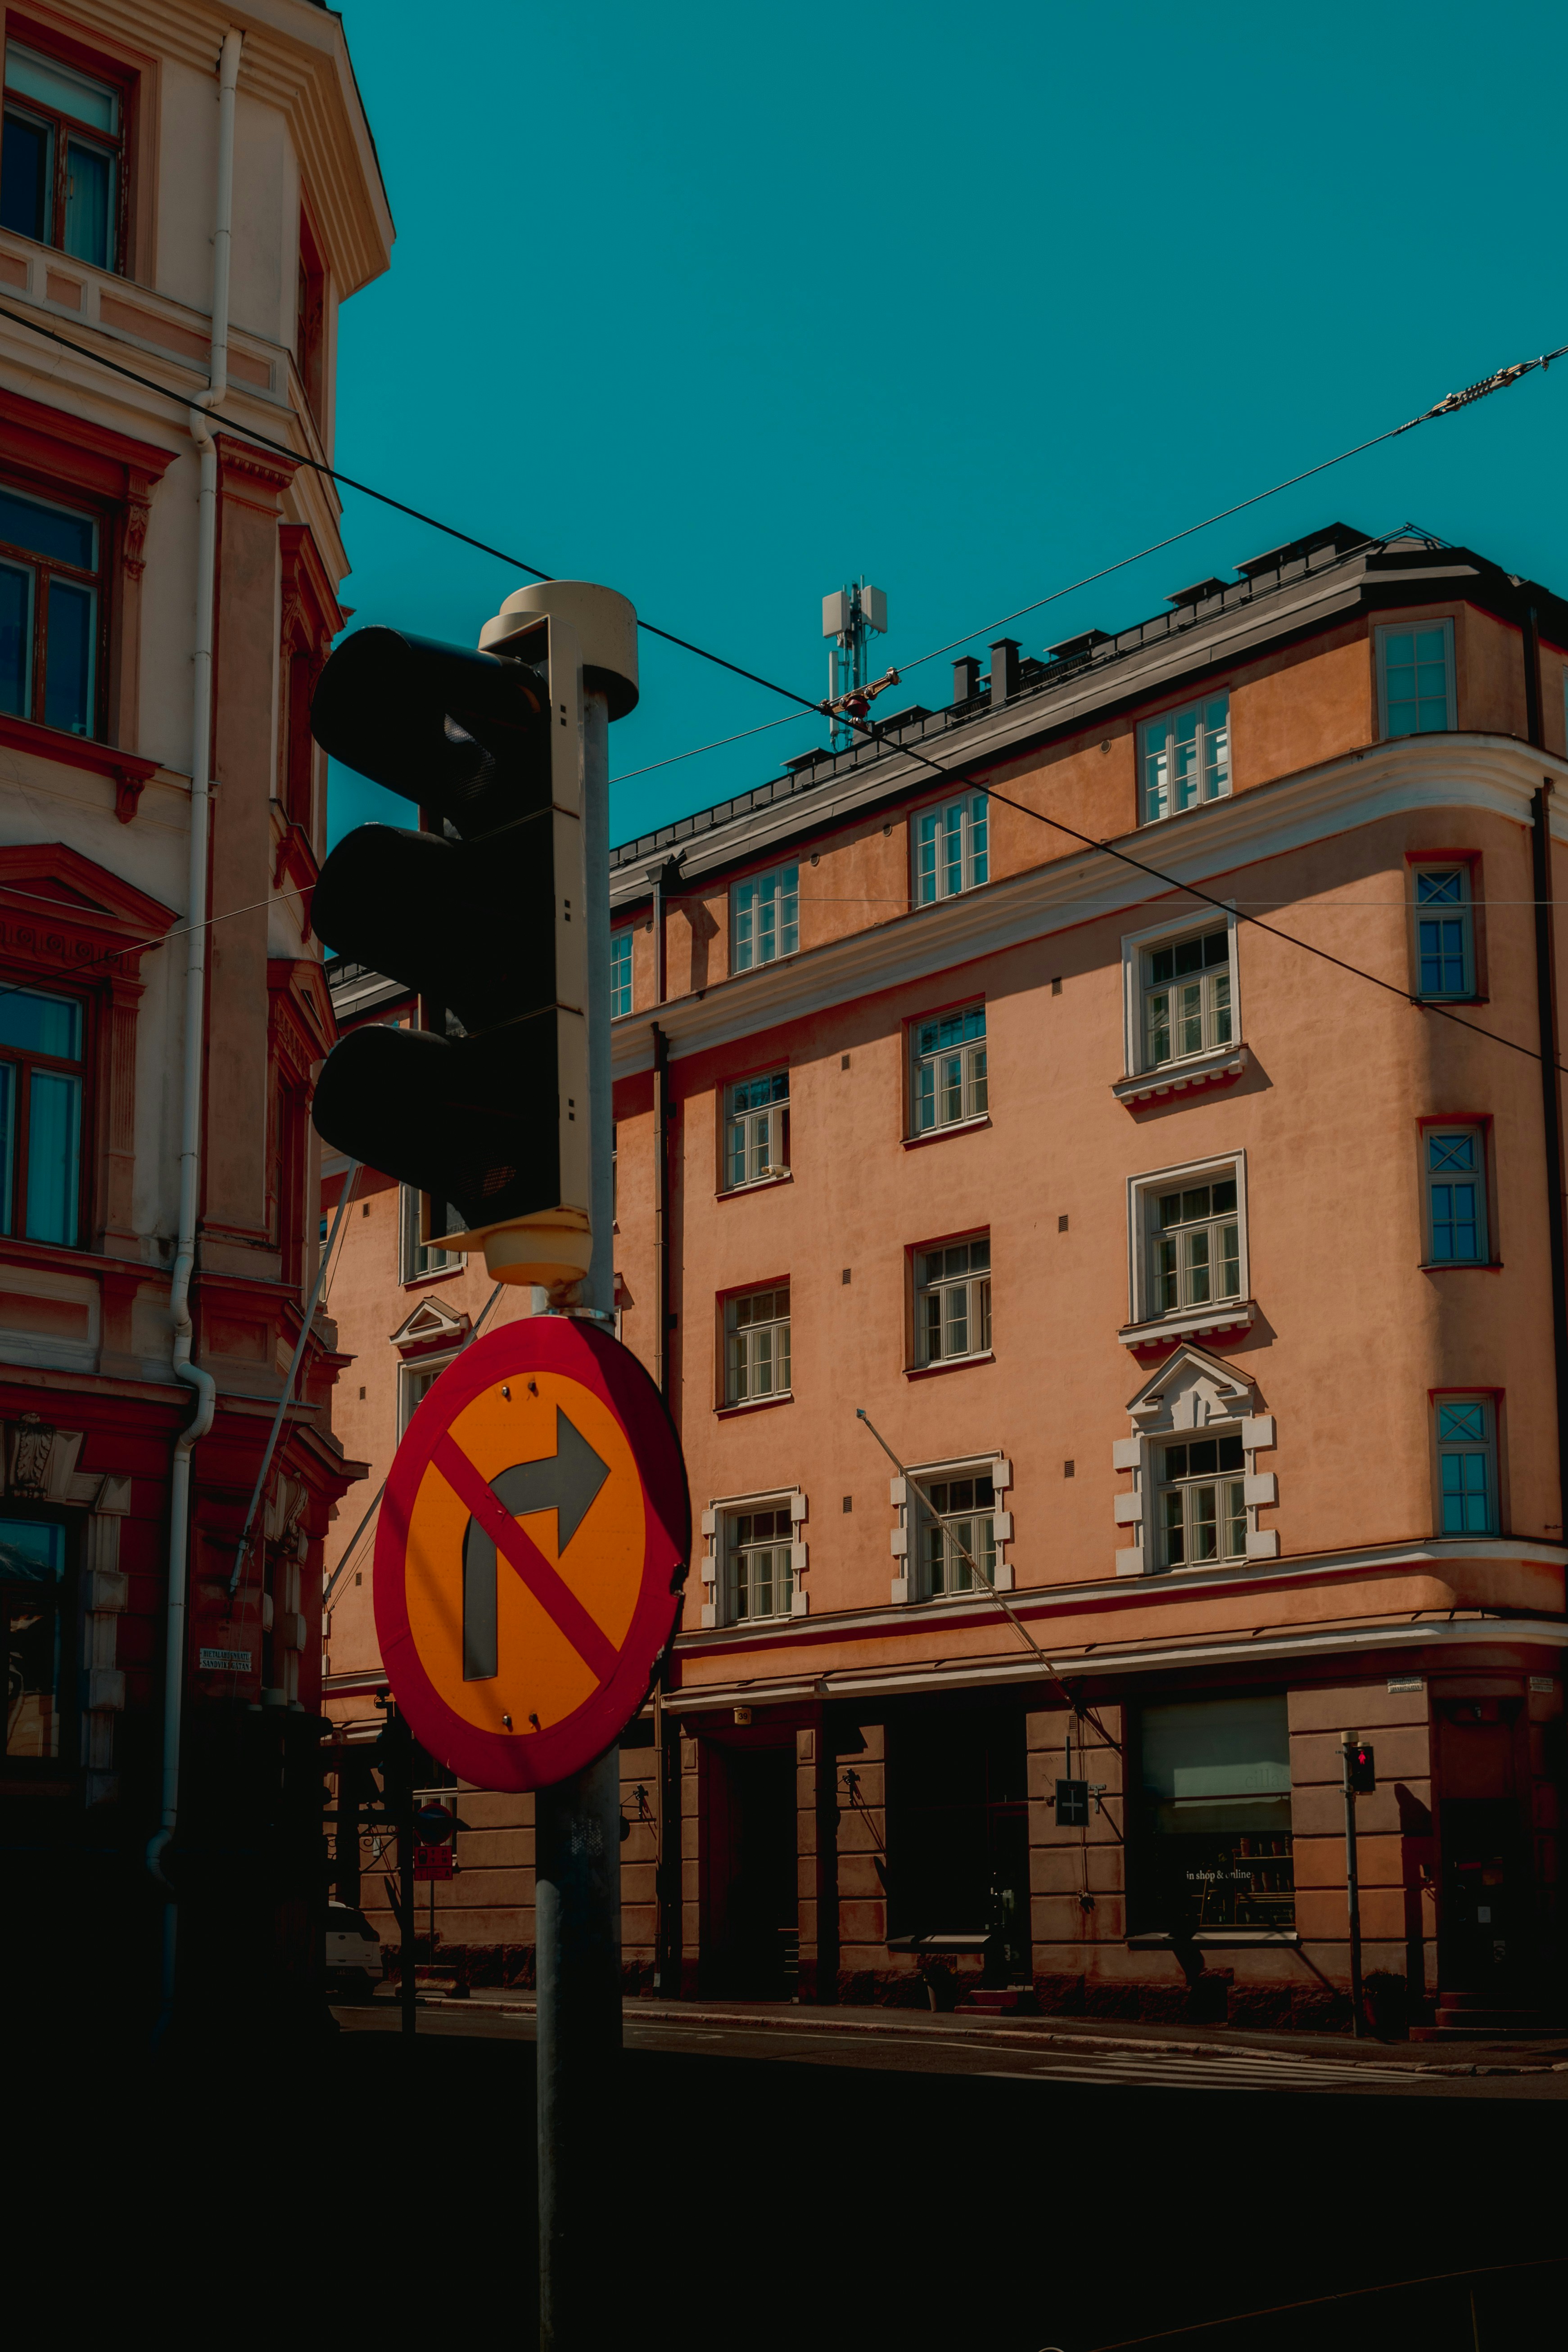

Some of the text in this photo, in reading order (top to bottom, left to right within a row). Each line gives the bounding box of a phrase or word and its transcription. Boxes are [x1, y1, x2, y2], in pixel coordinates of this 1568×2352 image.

[203, 1650, 249, 1660] HIETALAHDENKATU
[1245, 1768, 1290, 1788] cilla's
[1186, 1869, 1251, 1882] in shop & online
